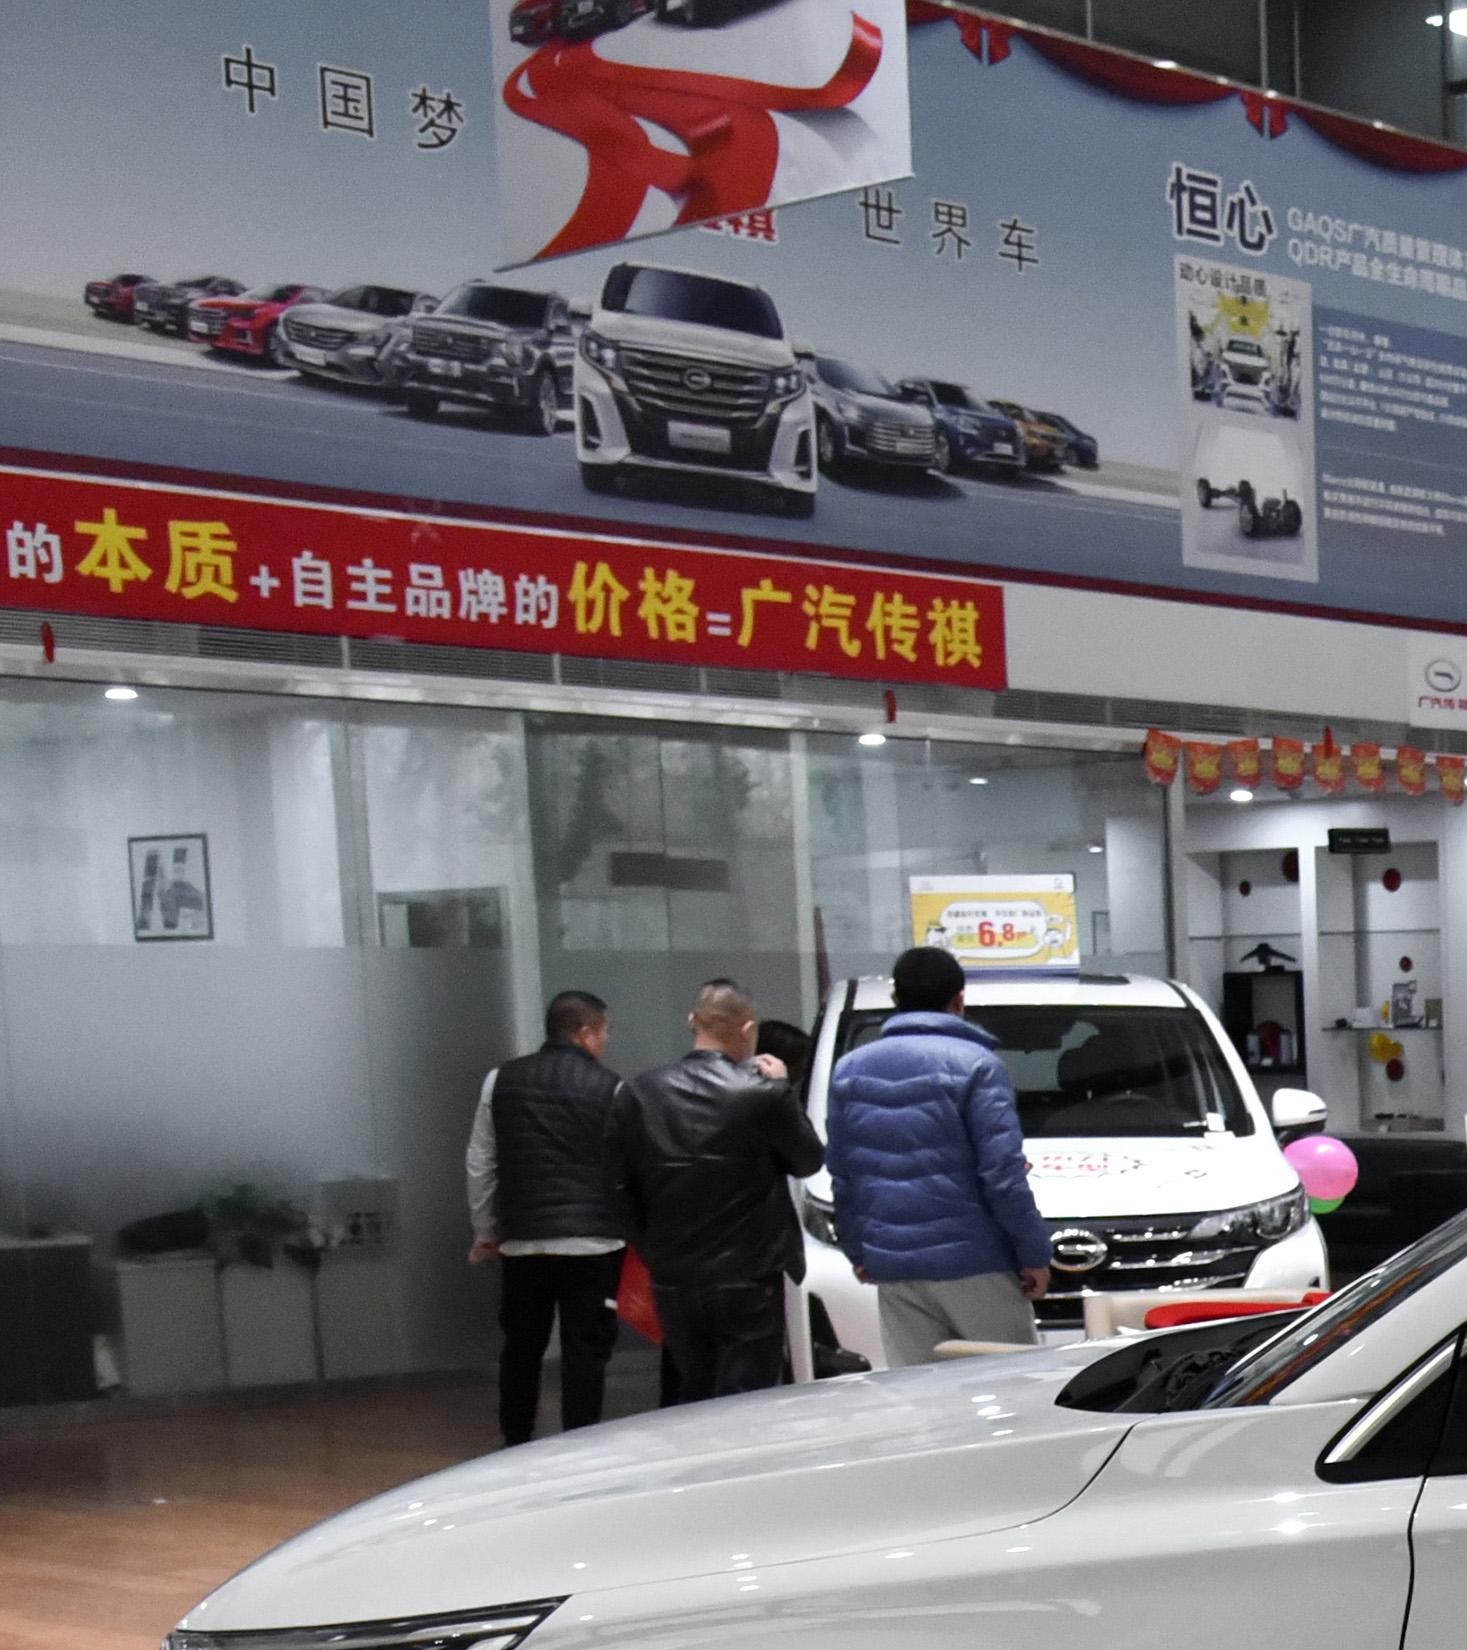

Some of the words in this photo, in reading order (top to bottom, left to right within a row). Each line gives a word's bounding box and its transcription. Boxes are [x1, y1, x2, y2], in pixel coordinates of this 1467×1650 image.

[222, 46, 466, 150] 中国梦
[859, 187, 1040, 273] 世界车
[1169, 164, 1275, 254] 恒心
